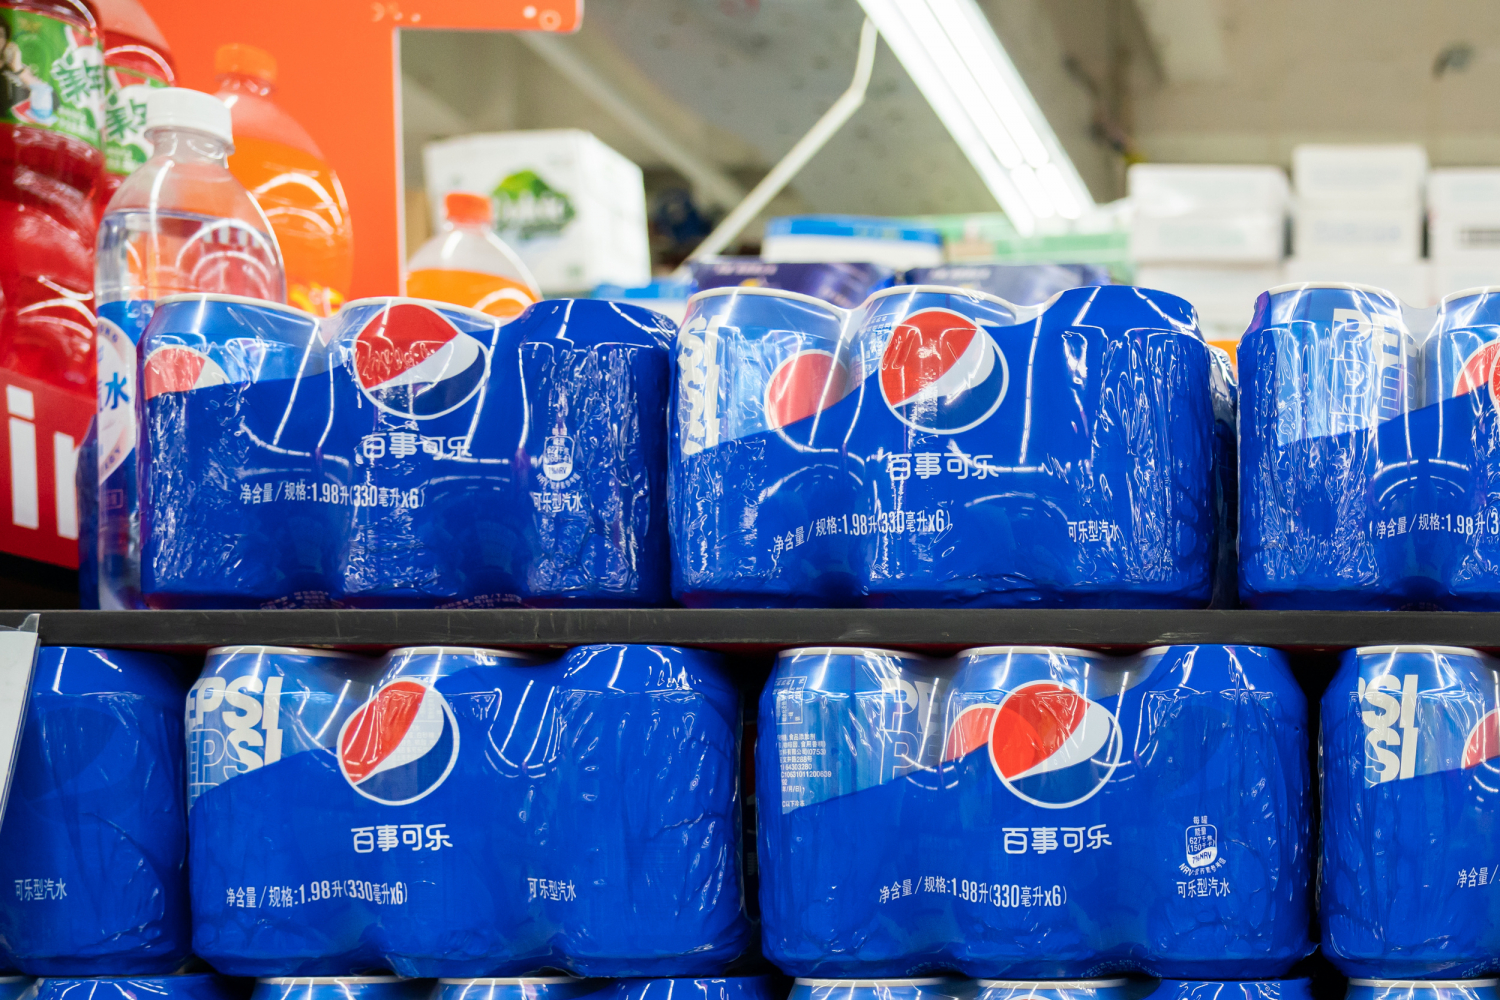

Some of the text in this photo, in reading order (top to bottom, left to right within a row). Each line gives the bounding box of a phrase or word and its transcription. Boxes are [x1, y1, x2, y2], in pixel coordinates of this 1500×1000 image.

[363, 431, 471, 459] 百事可乐
[889, 451, 998, 481] 百事可乐
[1067, 519, 1119, 543] 可乐型汽水
[351, 824, 453, 853] 百事可乐
[1002, 824, 1112, 853] 百事可乐
[14, 879, 67, 900] 可乐型汽水
[528, 878, 576, 902] 可乐型汽水
[1176, 877, 1230, 899] 可乐型汽水
